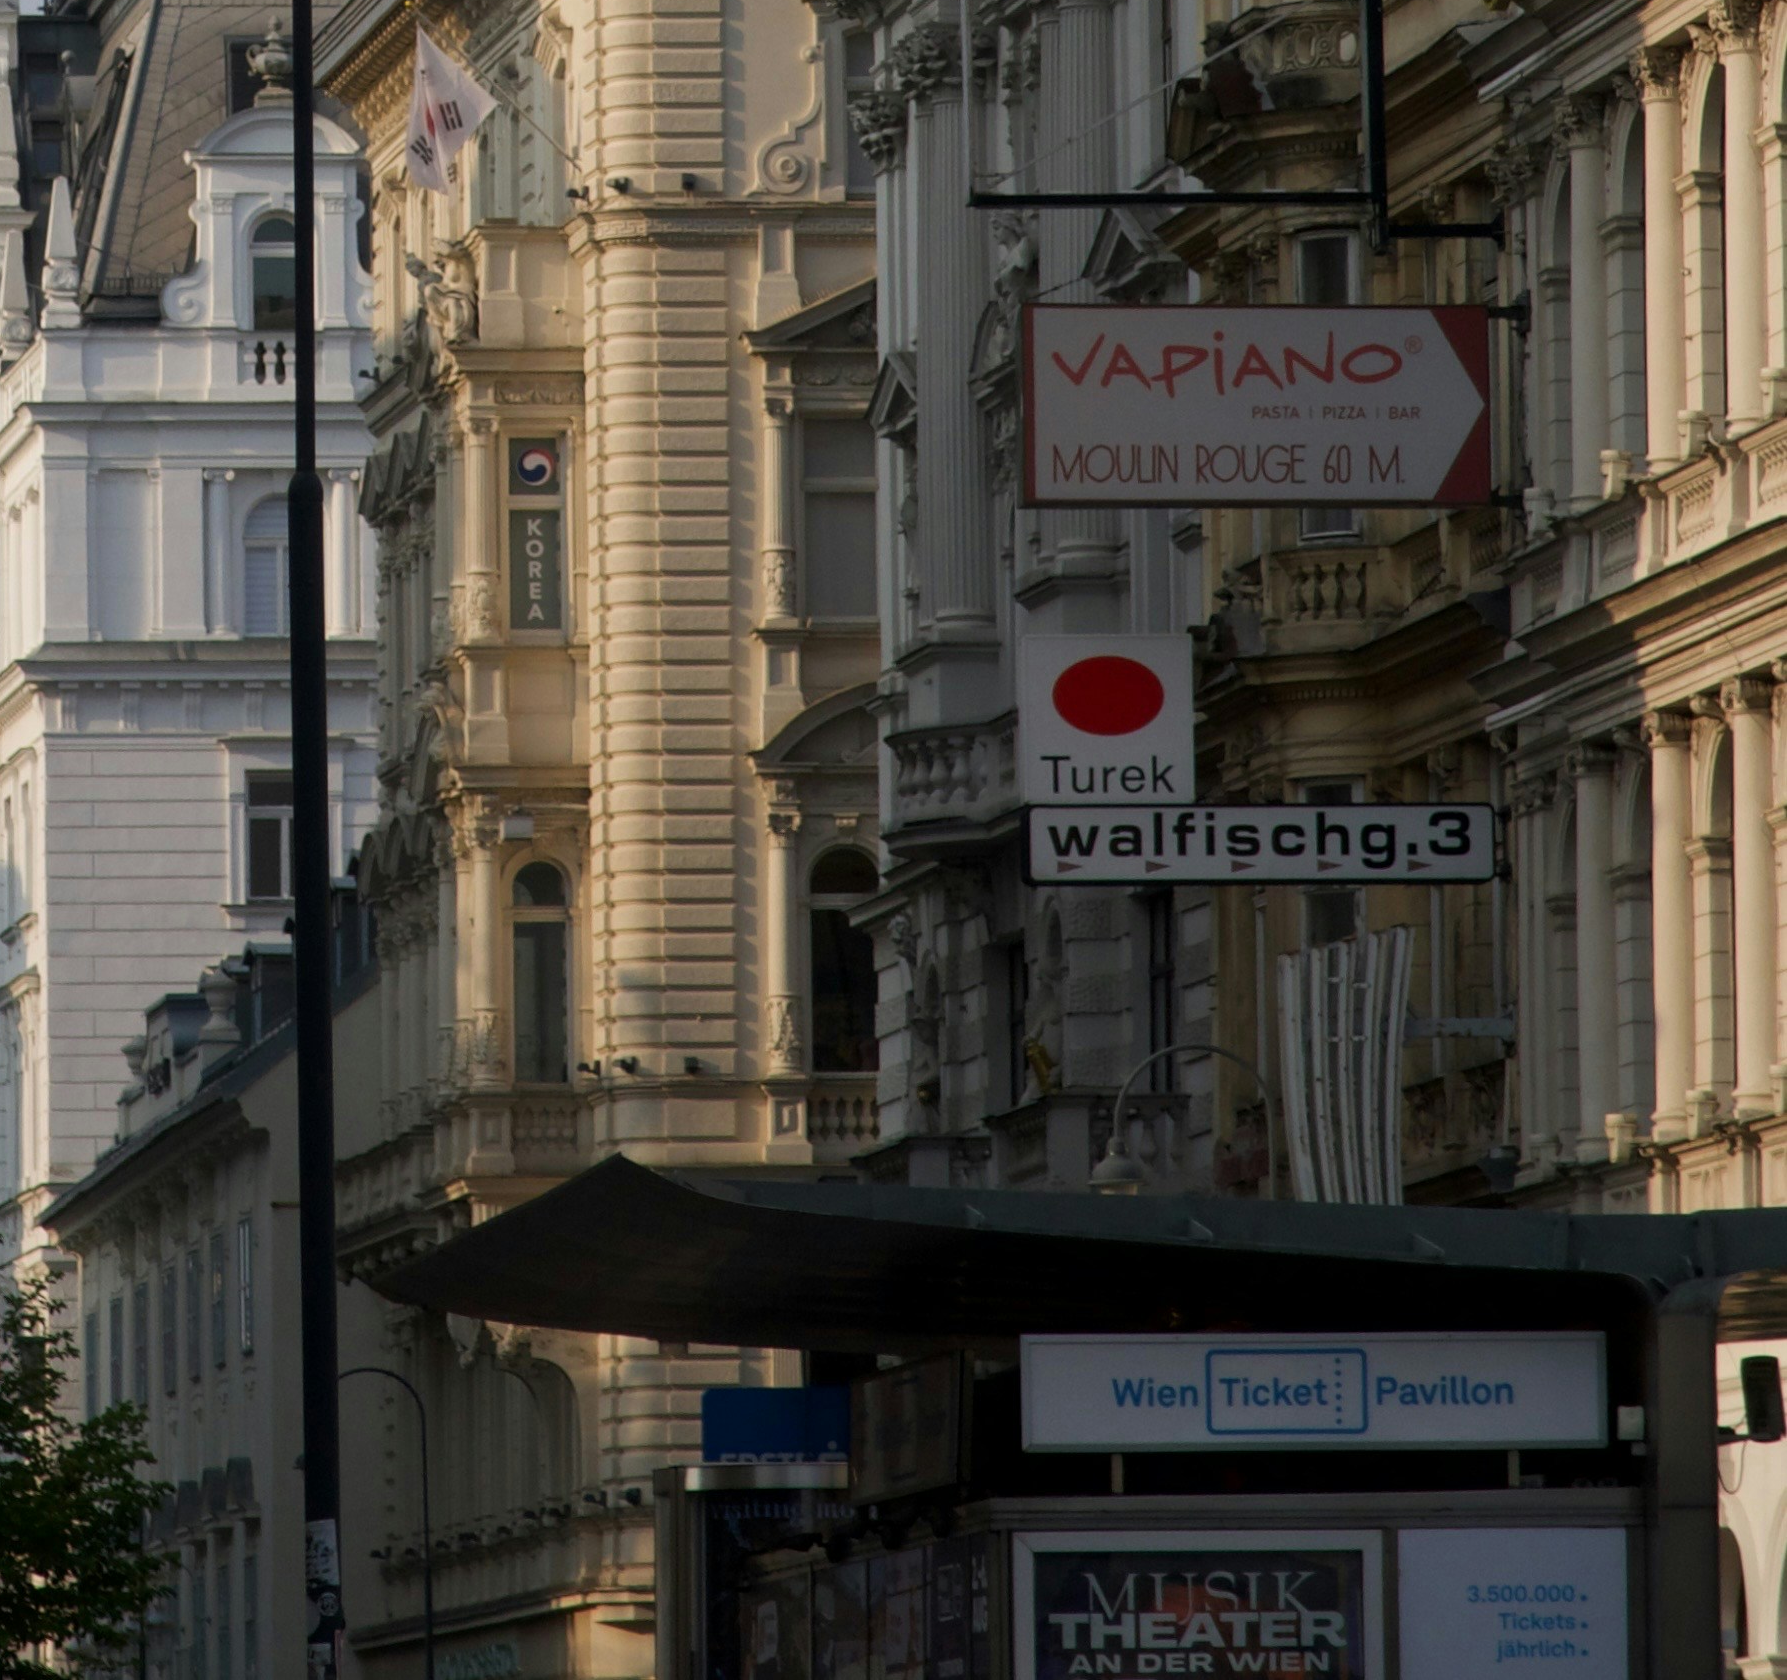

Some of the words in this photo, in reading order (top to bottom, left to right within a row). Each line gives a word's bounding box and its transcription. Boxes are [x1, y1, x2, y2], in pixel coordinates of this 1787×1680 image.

[1251, 405, 1300, 420] PASTA
[1322, 405, 1367, 420] PIZZA
[1388, 405, 1421, 420] BAR
[1052, 444, 1178, 484] MOULIN
[1195, 444, 1307, 484] ROUGE
[1323, 444, 1352, 484] 60
[1369, 444, 1406, 484] M.
[525, 518, 545, 621] KOREA
[1040, 755, 1175, 794] Turek
[1047, 811, 1471, 870] walfischg.3
[1112, 1377, 1199, 1407] Wien
[1218, 1377, 1329, 1407] Ticket
[1376, 1375, 1515, 1406] Pavillon
[1081, 1570, 1317, 1623] MUSIK
[1467, 1584, 1576, 1603] 3.500.000
[1047, 1610, 1349, 1650] THEATER
[1498, 1612, 1576, 1631] Tickets
[1068, 1652, 1122, 1674] AN
[1137, 1651, 1215, 1673] DER
[1226, 1650, 1330, 1672] WIEN
[1496, 1640, 1576, 1663] jährlich
